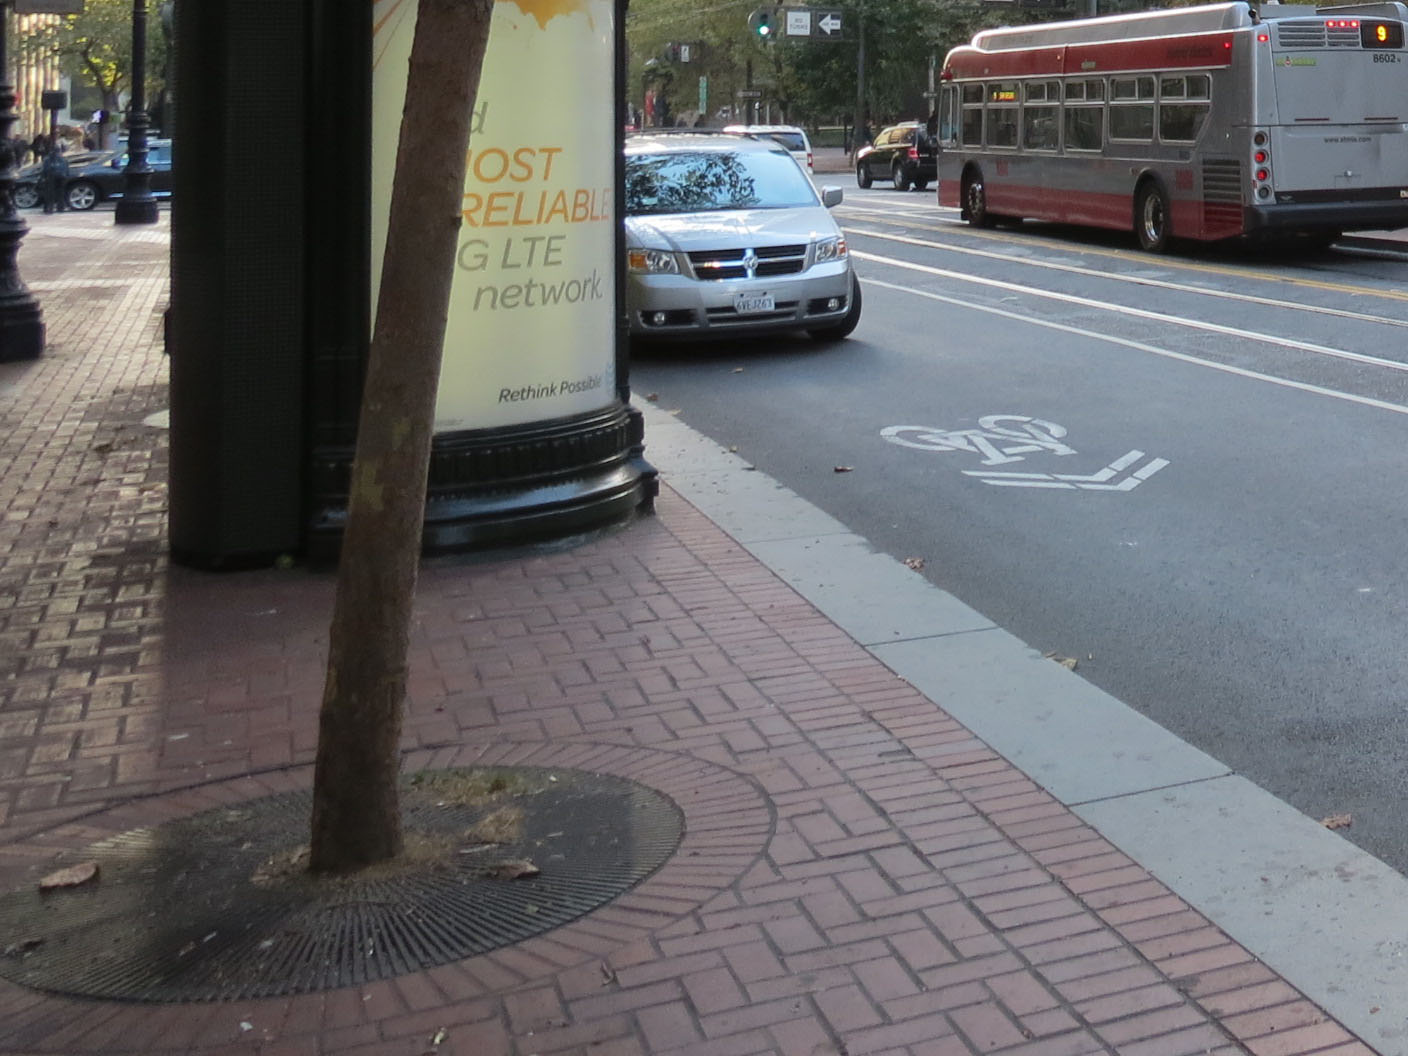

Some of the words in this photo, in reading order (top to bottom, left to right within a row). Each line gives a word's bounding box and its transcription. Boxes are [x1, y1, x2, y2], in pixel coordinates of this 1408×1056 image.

[1376, 25, 1387, 42] 9
[1373, 54, 1396, 64] 8602
[465, 147, 563, 183] OST
[501, 235, 566, 270] LTE
[498, 384, 557, 404] Rethink
[559, 375, 601, 395] Possible
